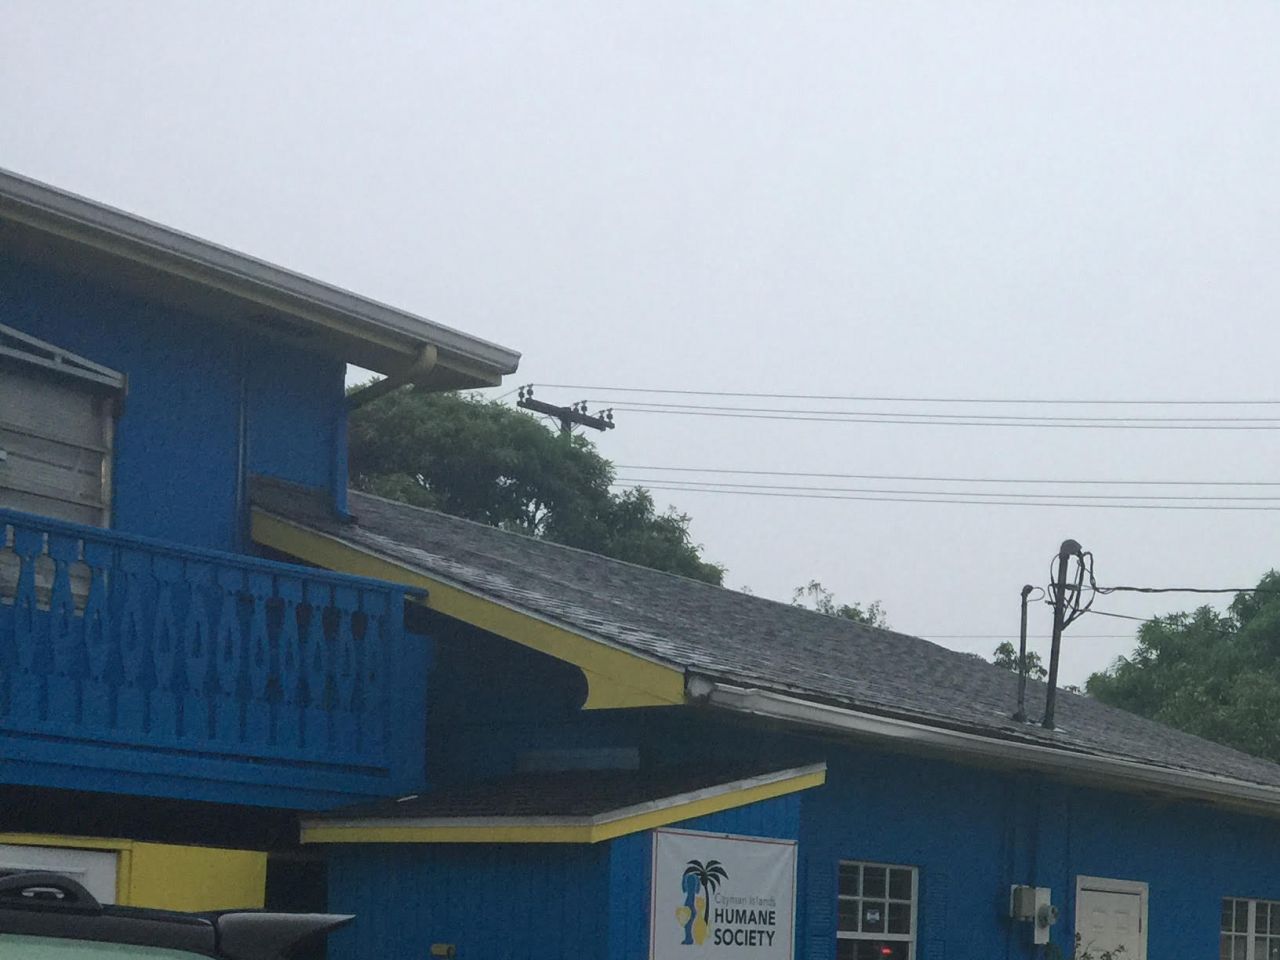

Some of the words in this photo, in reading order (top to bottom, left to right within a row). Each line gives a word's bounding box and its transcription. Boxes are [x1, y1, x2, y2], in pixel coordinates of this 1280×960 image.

[714, 892, 747, 907] Cayman
[714, 908, 776, 926] HUMANE
[714, 928, 776, 947] SOCIETY
